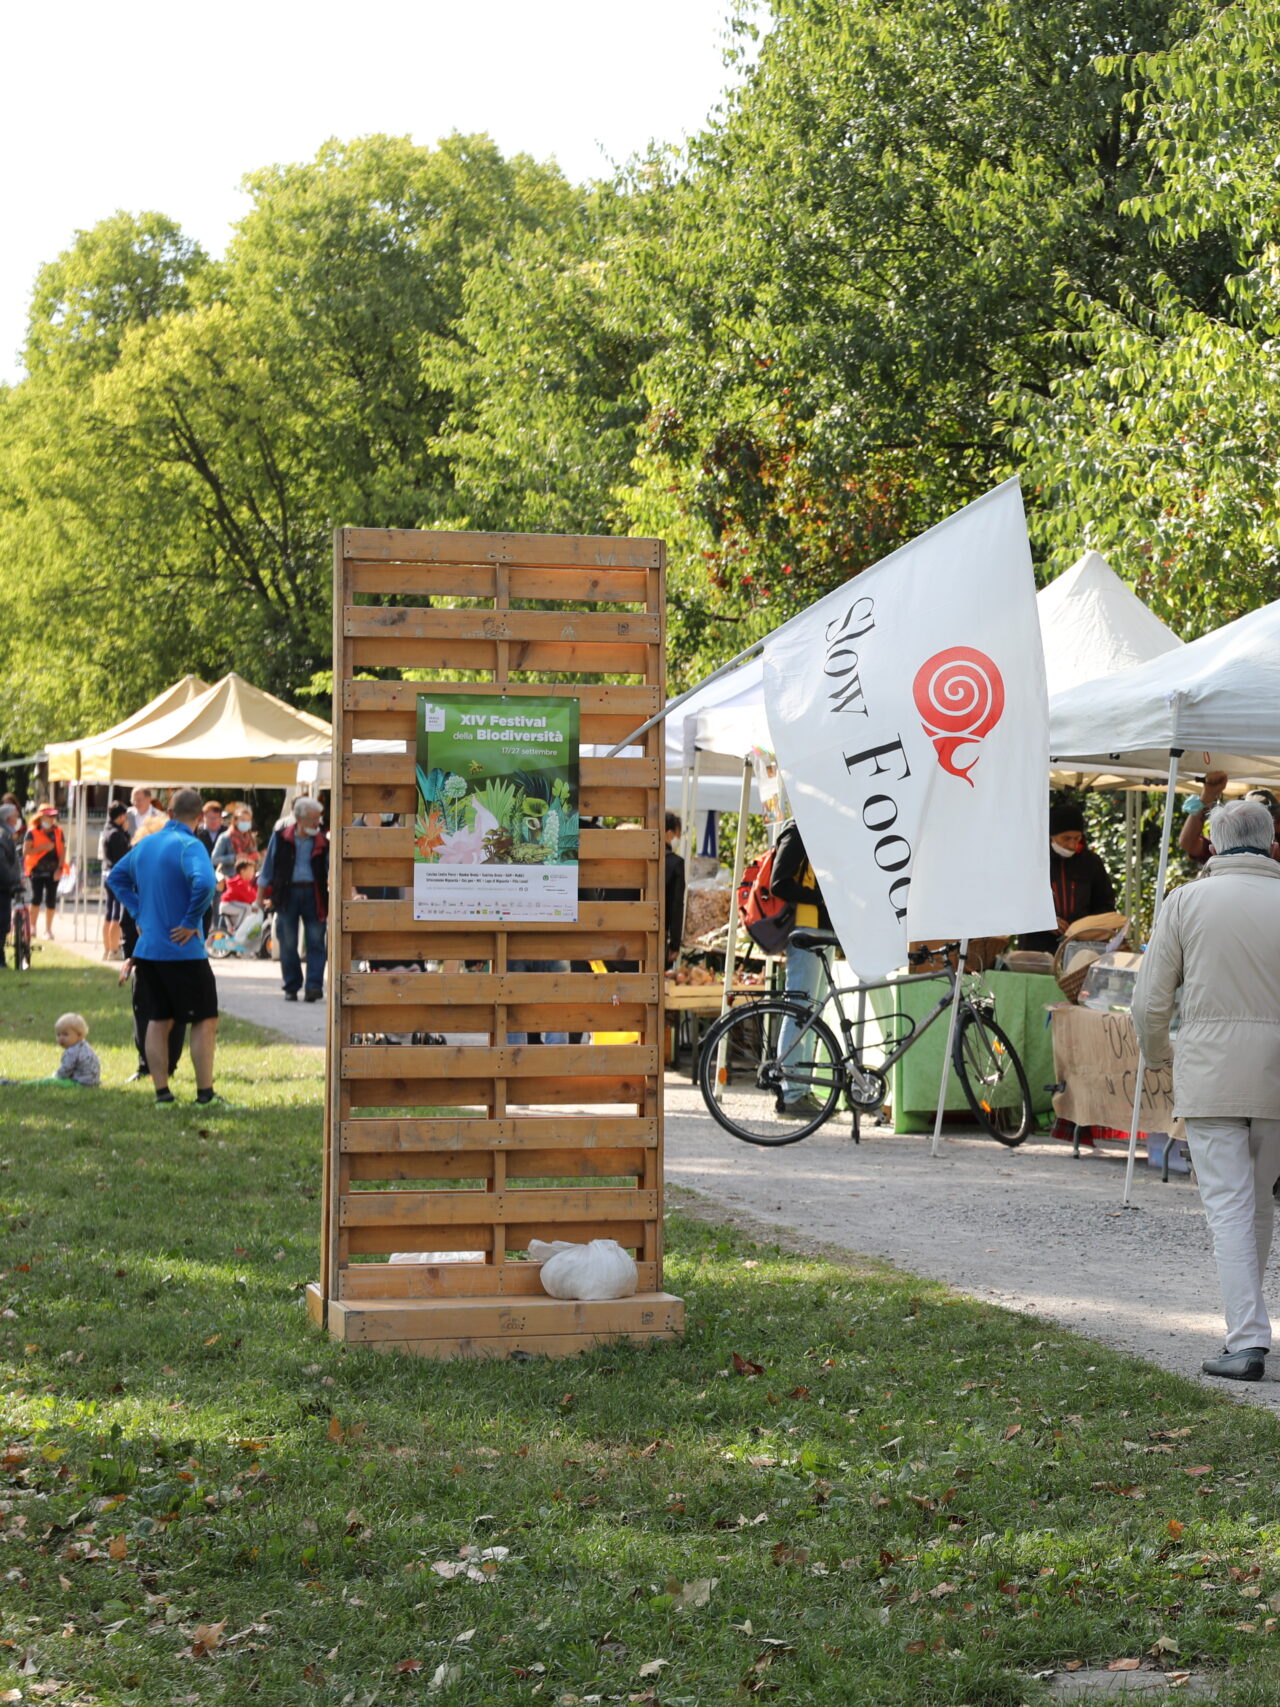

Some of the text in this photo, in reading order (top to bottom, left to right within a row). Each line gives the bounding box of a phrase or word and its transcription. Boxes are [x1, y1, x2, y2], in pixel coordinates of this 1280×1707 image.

[823, 597, 875, 718] Slow
[460, 714, 547, 728] XIV Festival
[453, 728, 564, 743] della Biodiversità
[501, 746, 558, 756] 17/27 settembre
